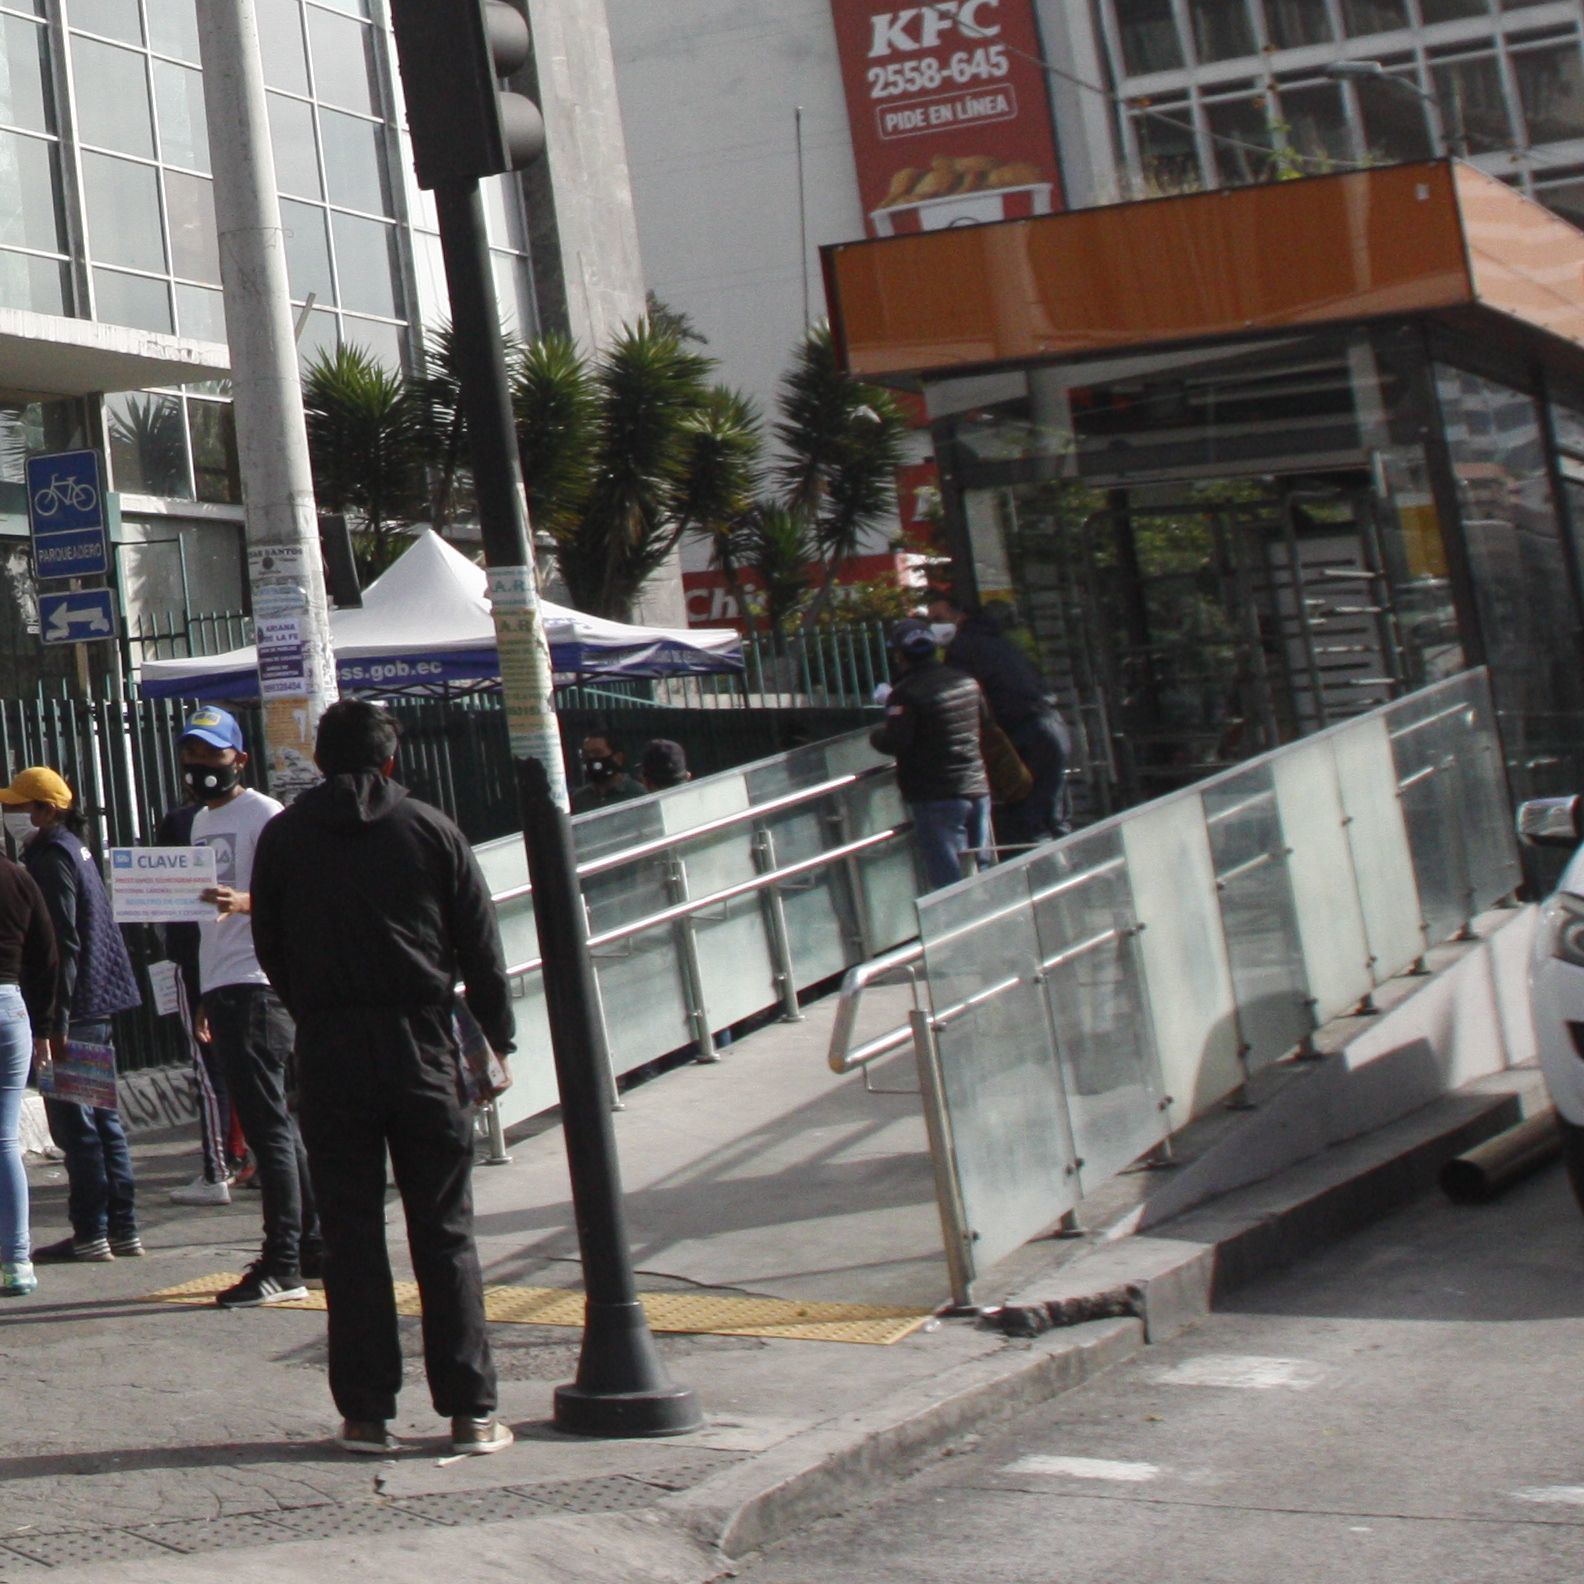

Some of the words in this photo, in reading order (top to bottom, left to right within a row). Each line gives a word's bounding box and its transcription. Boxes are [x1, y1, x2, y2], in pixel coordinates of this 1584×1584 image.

[868, 44, 1009, 100] 2558-645
[885, 108, 927, 133] PIDE
[929, 105, 953, 125] EN
[955, 95, 1009, 120] LÍNEA
[38, 541, 103, 564] PARQUEADERO
[137, 854, 188, 869] CLAVE
